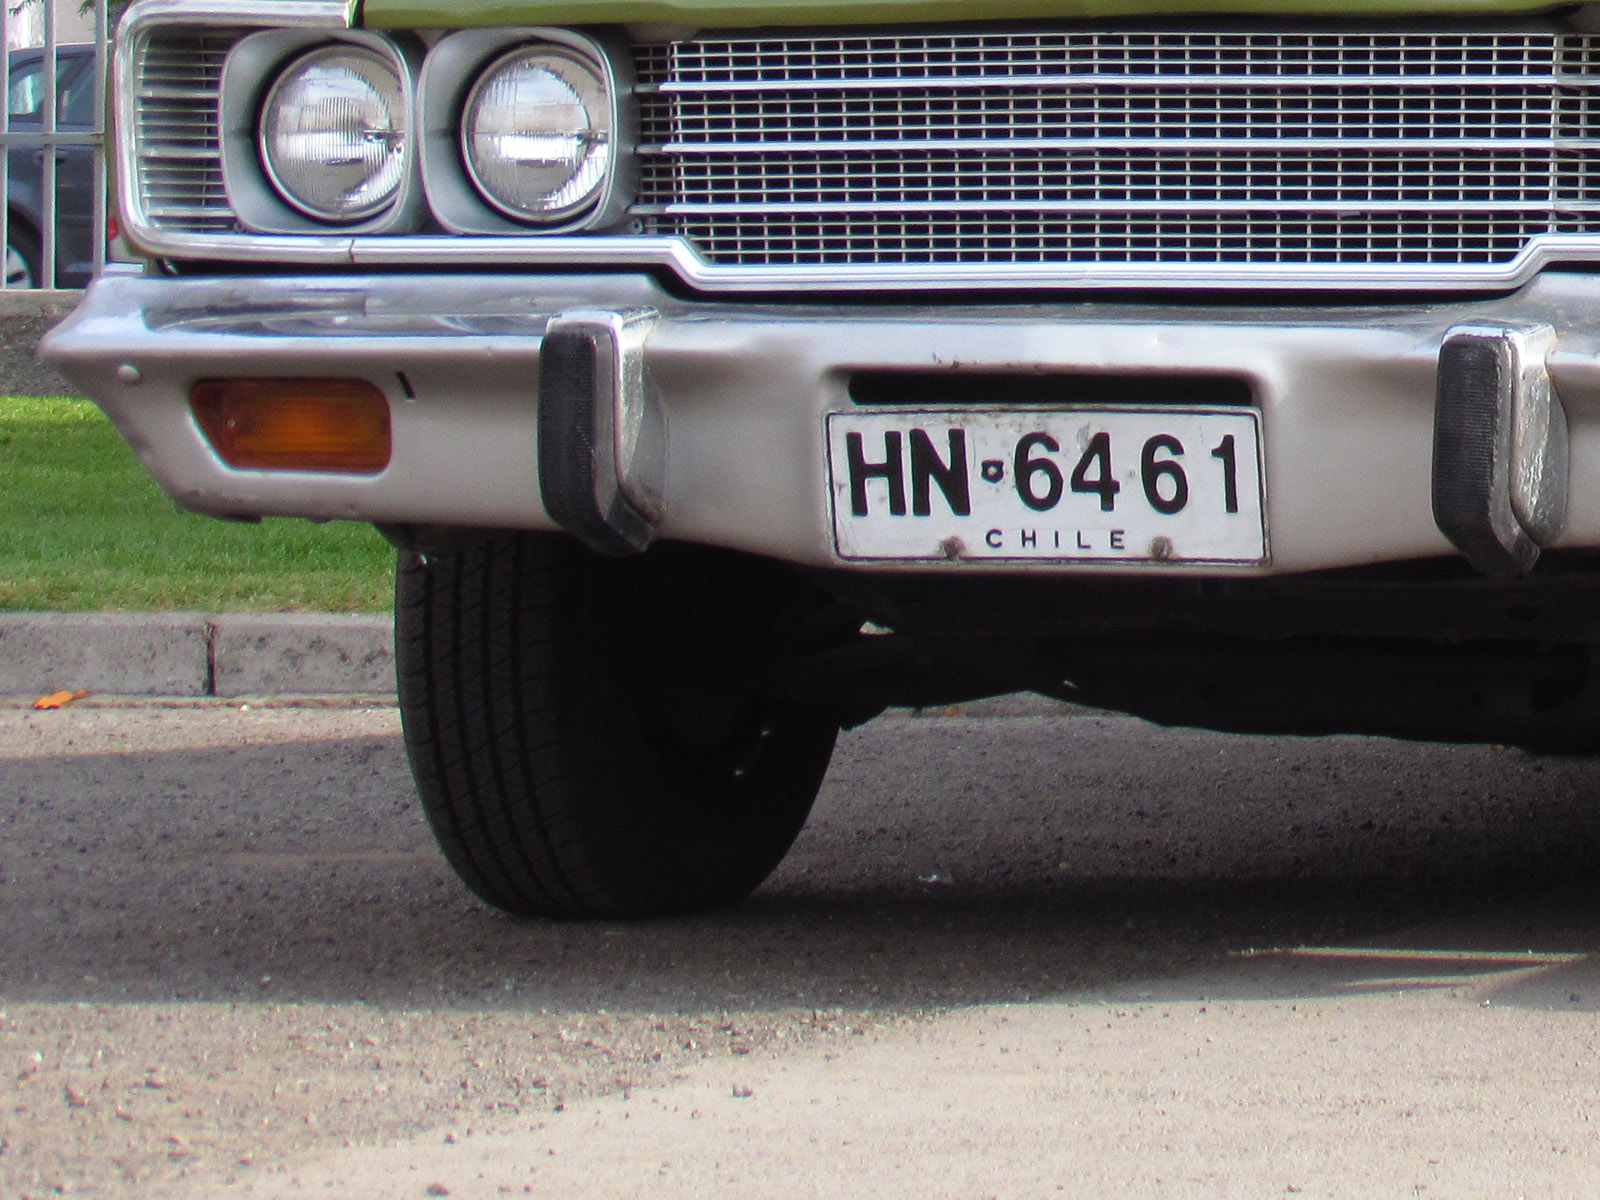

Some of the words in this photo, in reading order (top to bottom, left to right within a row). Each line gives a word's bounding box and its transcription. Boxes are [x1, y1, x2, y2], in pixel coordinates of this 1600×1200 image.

[846, 428, 971, 517] HN
[1013, 431, 1240, 515] 6461
[985, 528, 1127, 550] CHILE
